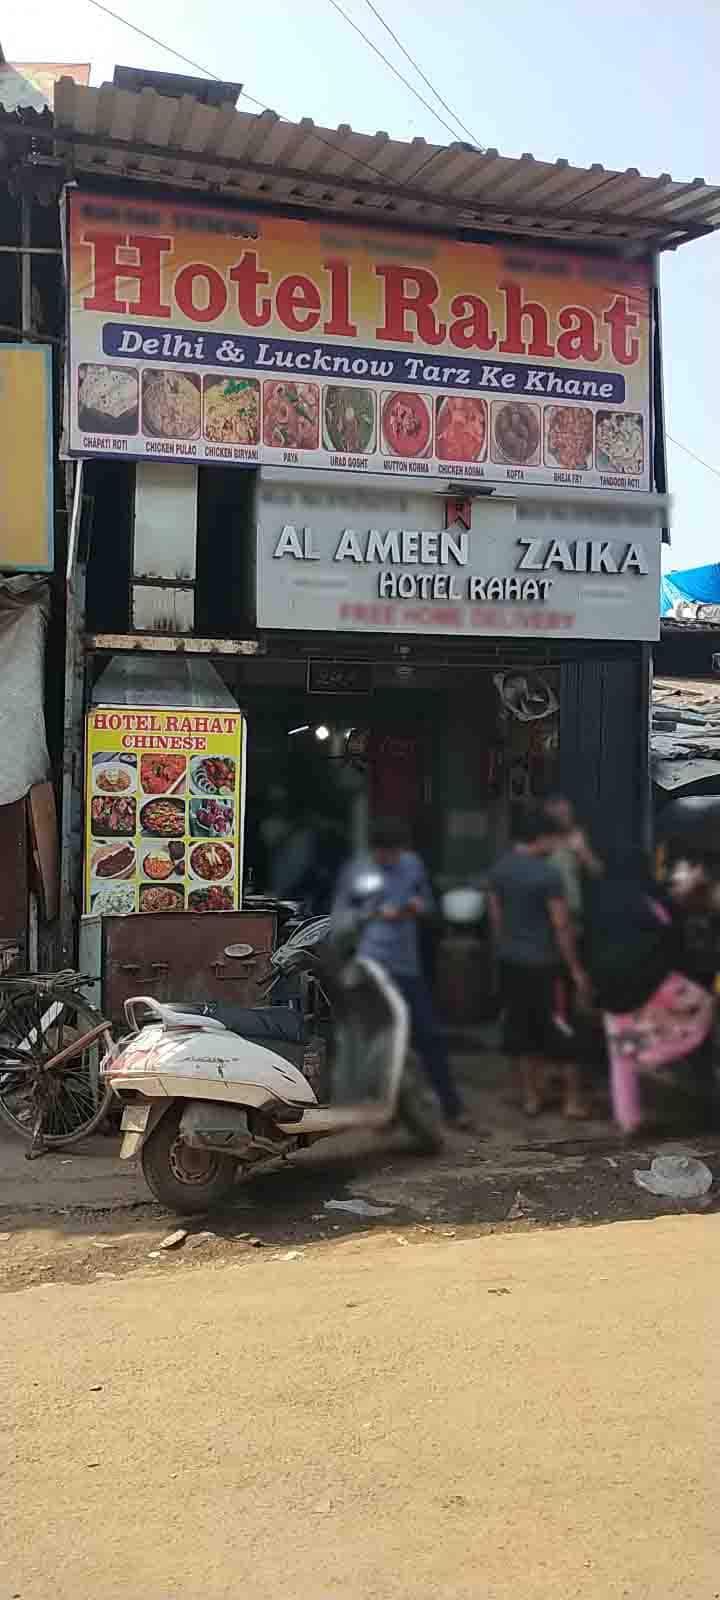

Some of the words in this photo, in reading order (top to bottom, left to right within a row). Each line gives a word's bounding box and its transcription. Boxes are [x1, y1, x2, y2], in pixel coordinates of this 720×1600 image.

[82, 232, 358, 338] Hotel
[375, 264, 640, 366] Rahat
[118, 330, 205, 359] Delhi
[215, 340, 245, 363] &
[255, 344, 393, 378] Lucknow
[404, 358, 471, 386] Tarz
[479, 366, 516, 389] Ke
[524, 370, 614, 399] Khane
[83, 437, 111, 449] CHAPATI
[113, 439, 128, 451] ROTI
[145, 441, 174, 453] CHICKEN
[175, 444, 197, 456] PULAO
[204, 446, 232, 458] CHICKEN
[233, 448, 259, 460] BIRYANI
[282, 452, 299, 463] PAYA
[384, 460, 408, 472] MUTTON
[438, 464, 463, 476] CHICKEN
[506, 469, 525, 480] KOFTA
[273, 525, 320, 560] AL
[334, 529, 470, 566] AMEEN
[518, 537, 649, 574] ZAIKA
[378, 571, 459, 600] HOTEL
[469, 576, 554, 601] RAHAT
[94, 714, 160, 731] HOTEL
[166, 716, 237, 734] RAHAT
[122, 735, 208, 750] CHINESE
